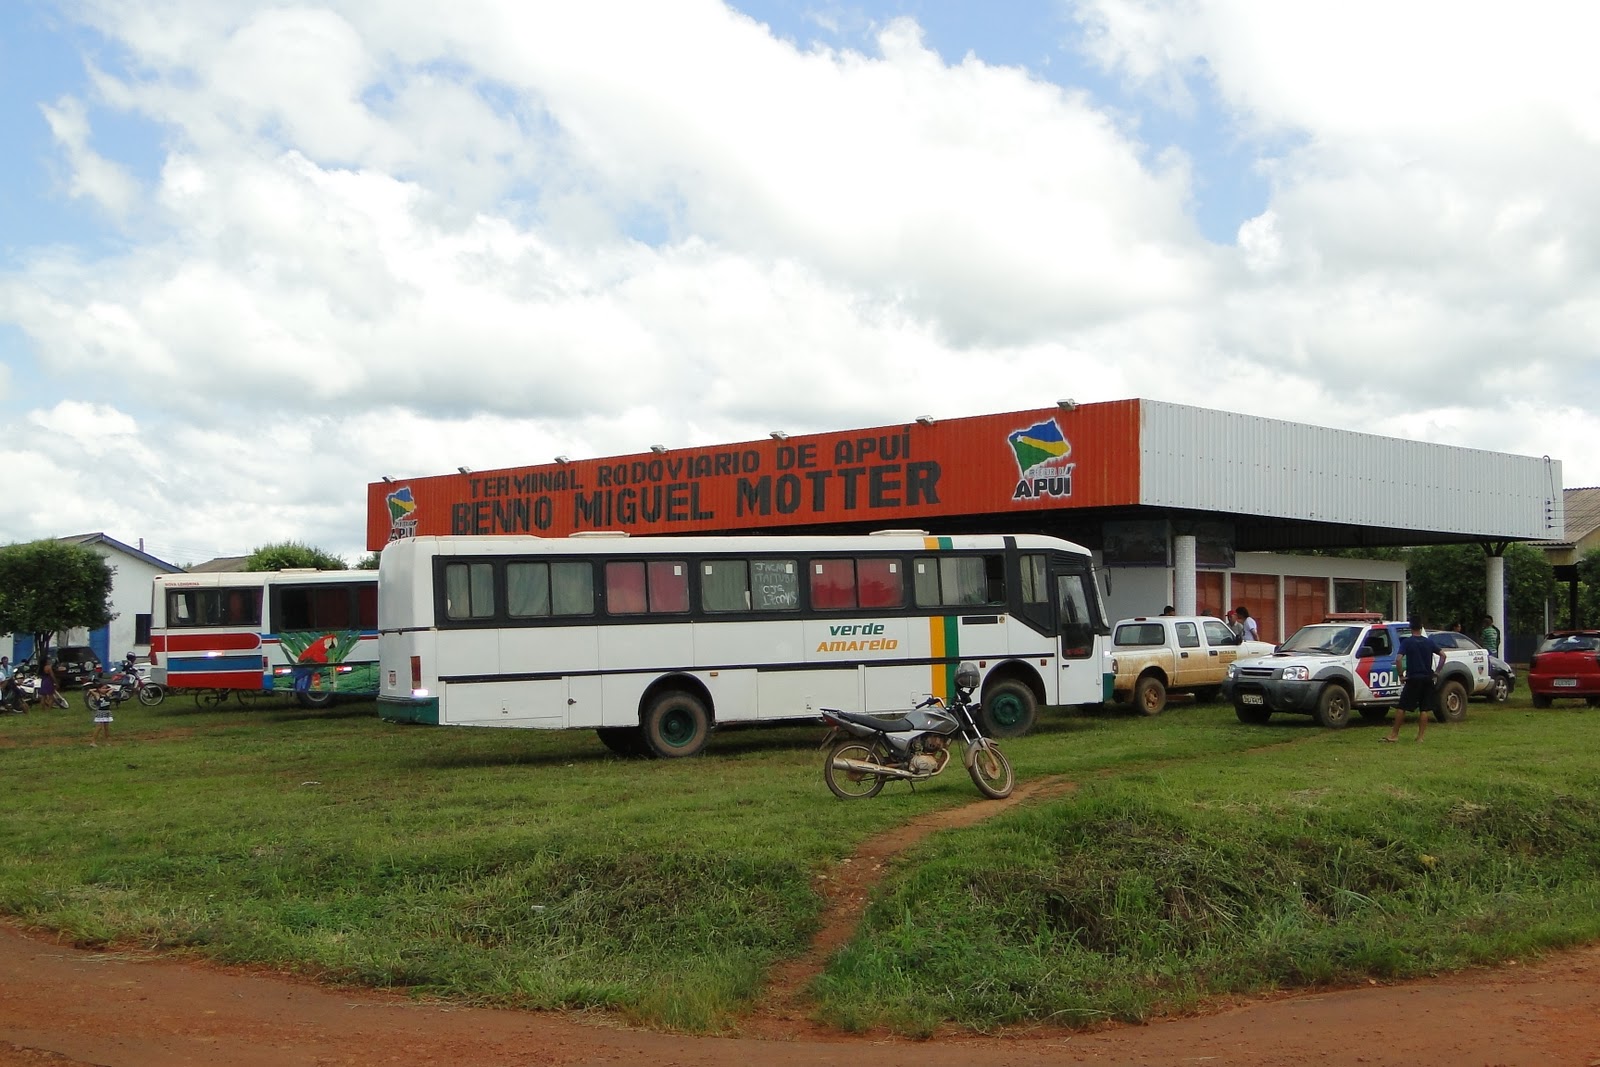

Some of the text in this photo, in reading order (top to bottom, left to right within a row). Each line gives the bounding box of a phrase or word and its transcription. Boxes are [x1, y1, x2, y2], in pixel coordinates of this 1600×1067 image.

[451, 460, 942, 536] BENNO MIGUEL MOTTER
[469, 468, 584, 499] TERMINAL
[597, 449, 760, 488] RODOVIARIO
[776, 443, 817, 471] DE
[829, 622, 885, 636] verde
